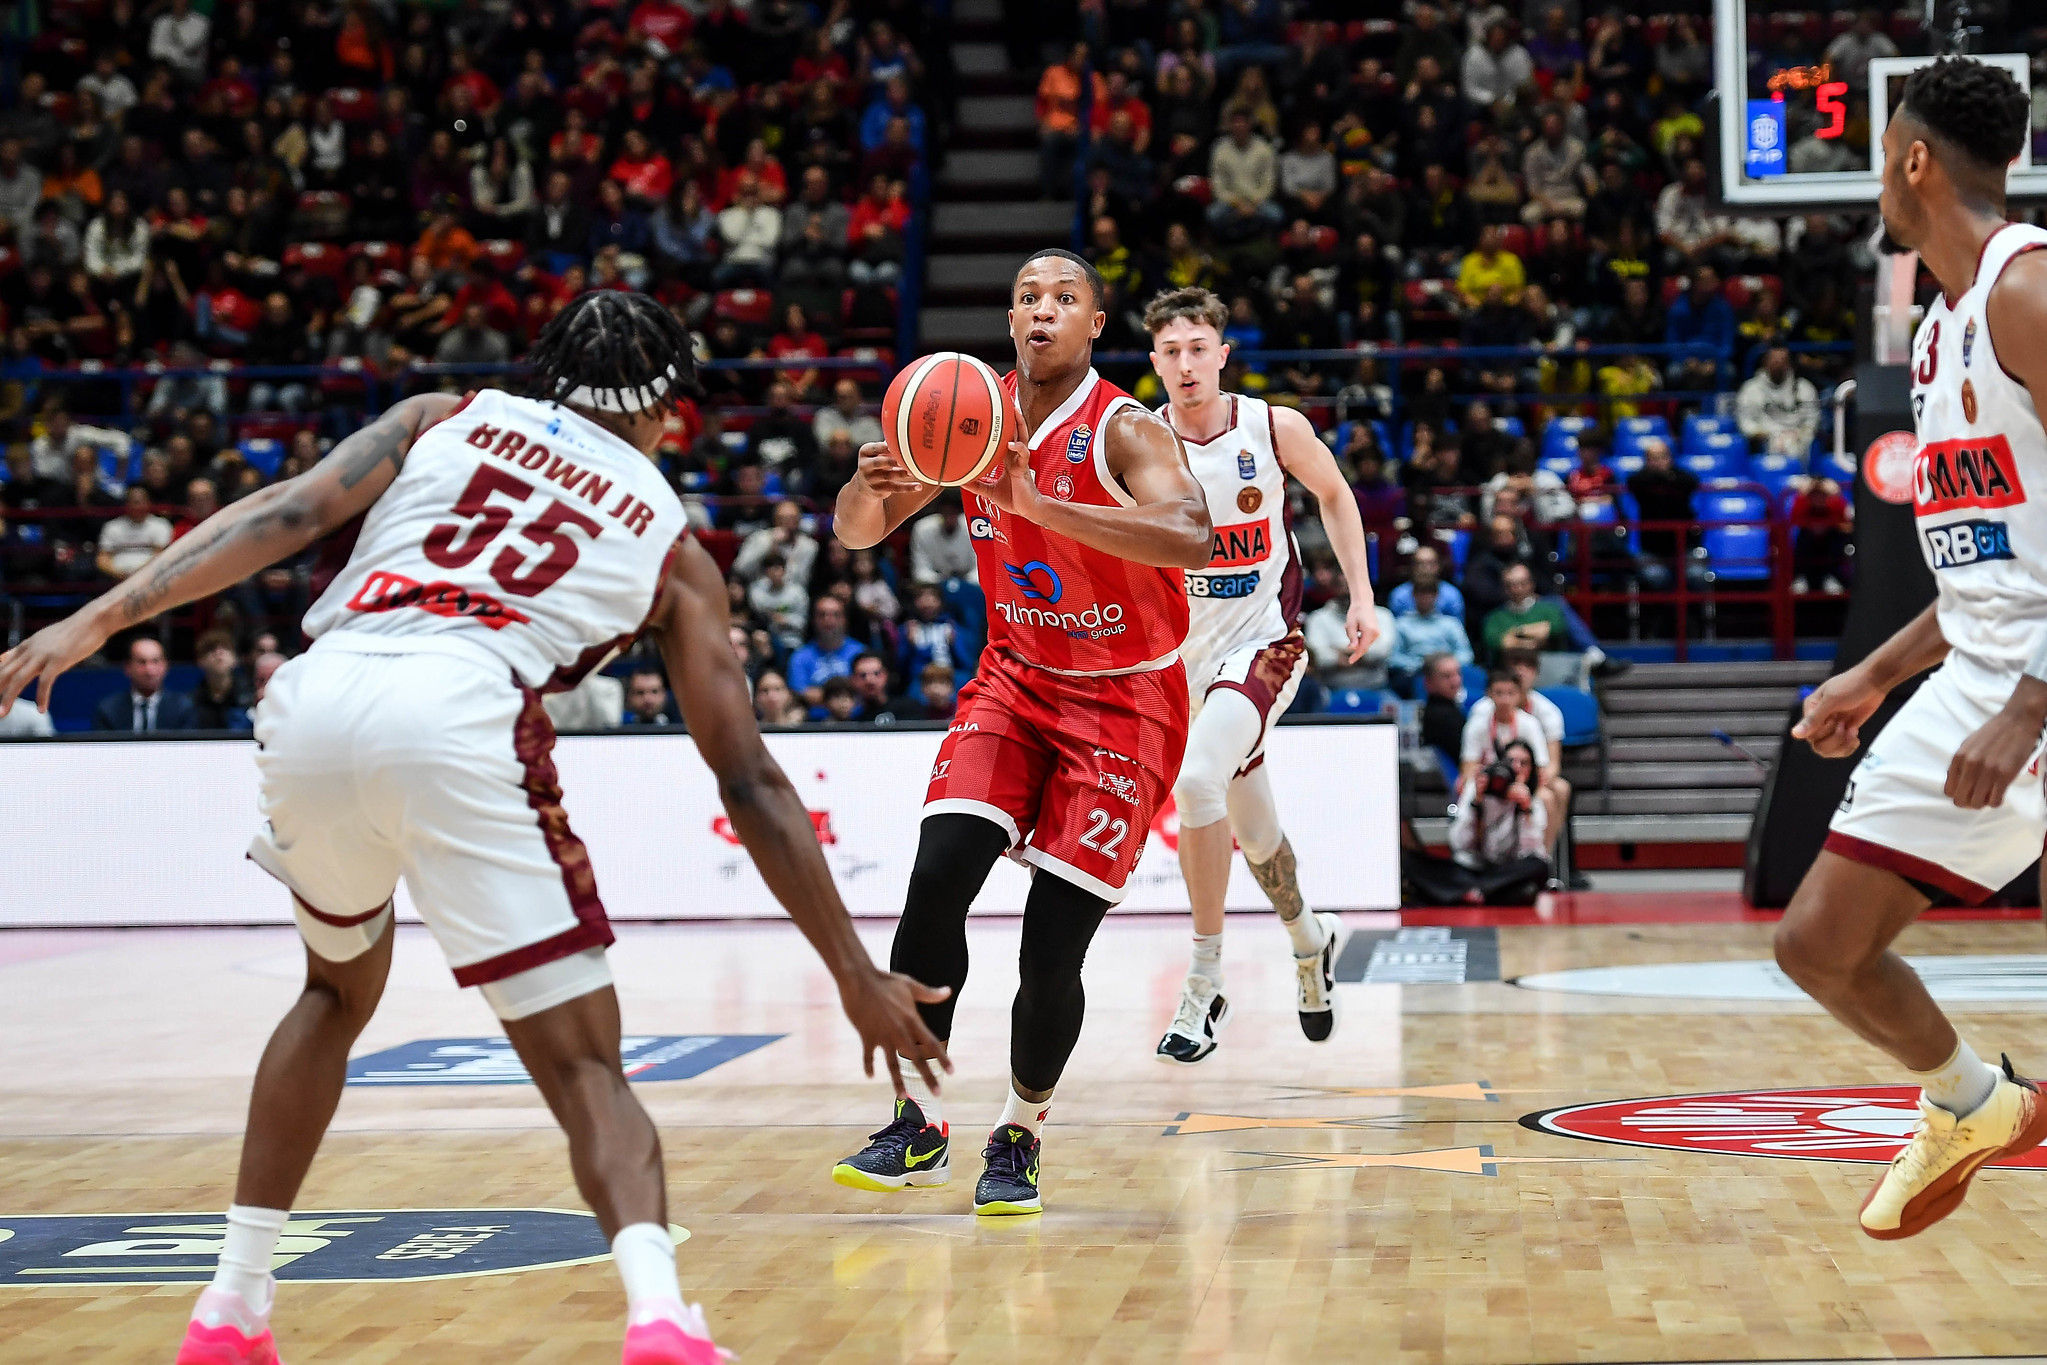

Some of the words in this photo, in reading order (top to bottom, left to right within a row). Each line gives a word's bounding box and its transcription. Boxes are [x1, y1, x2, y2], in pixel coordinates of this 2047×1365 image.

[1814, 82, 1849, 139] 5
[1911, 319, 1940, 388] 3
[1071, 438, 1087, 447] LBA
[465, 422, 614, 506] BROWN
[607, 492, 655, 538] JR
[422, 462, 605, 598] 55
[1210, 527, 1266, 561] ANA
[1090, 623, 1127, 640] group
[1078, 807, 1129, 861] 22
